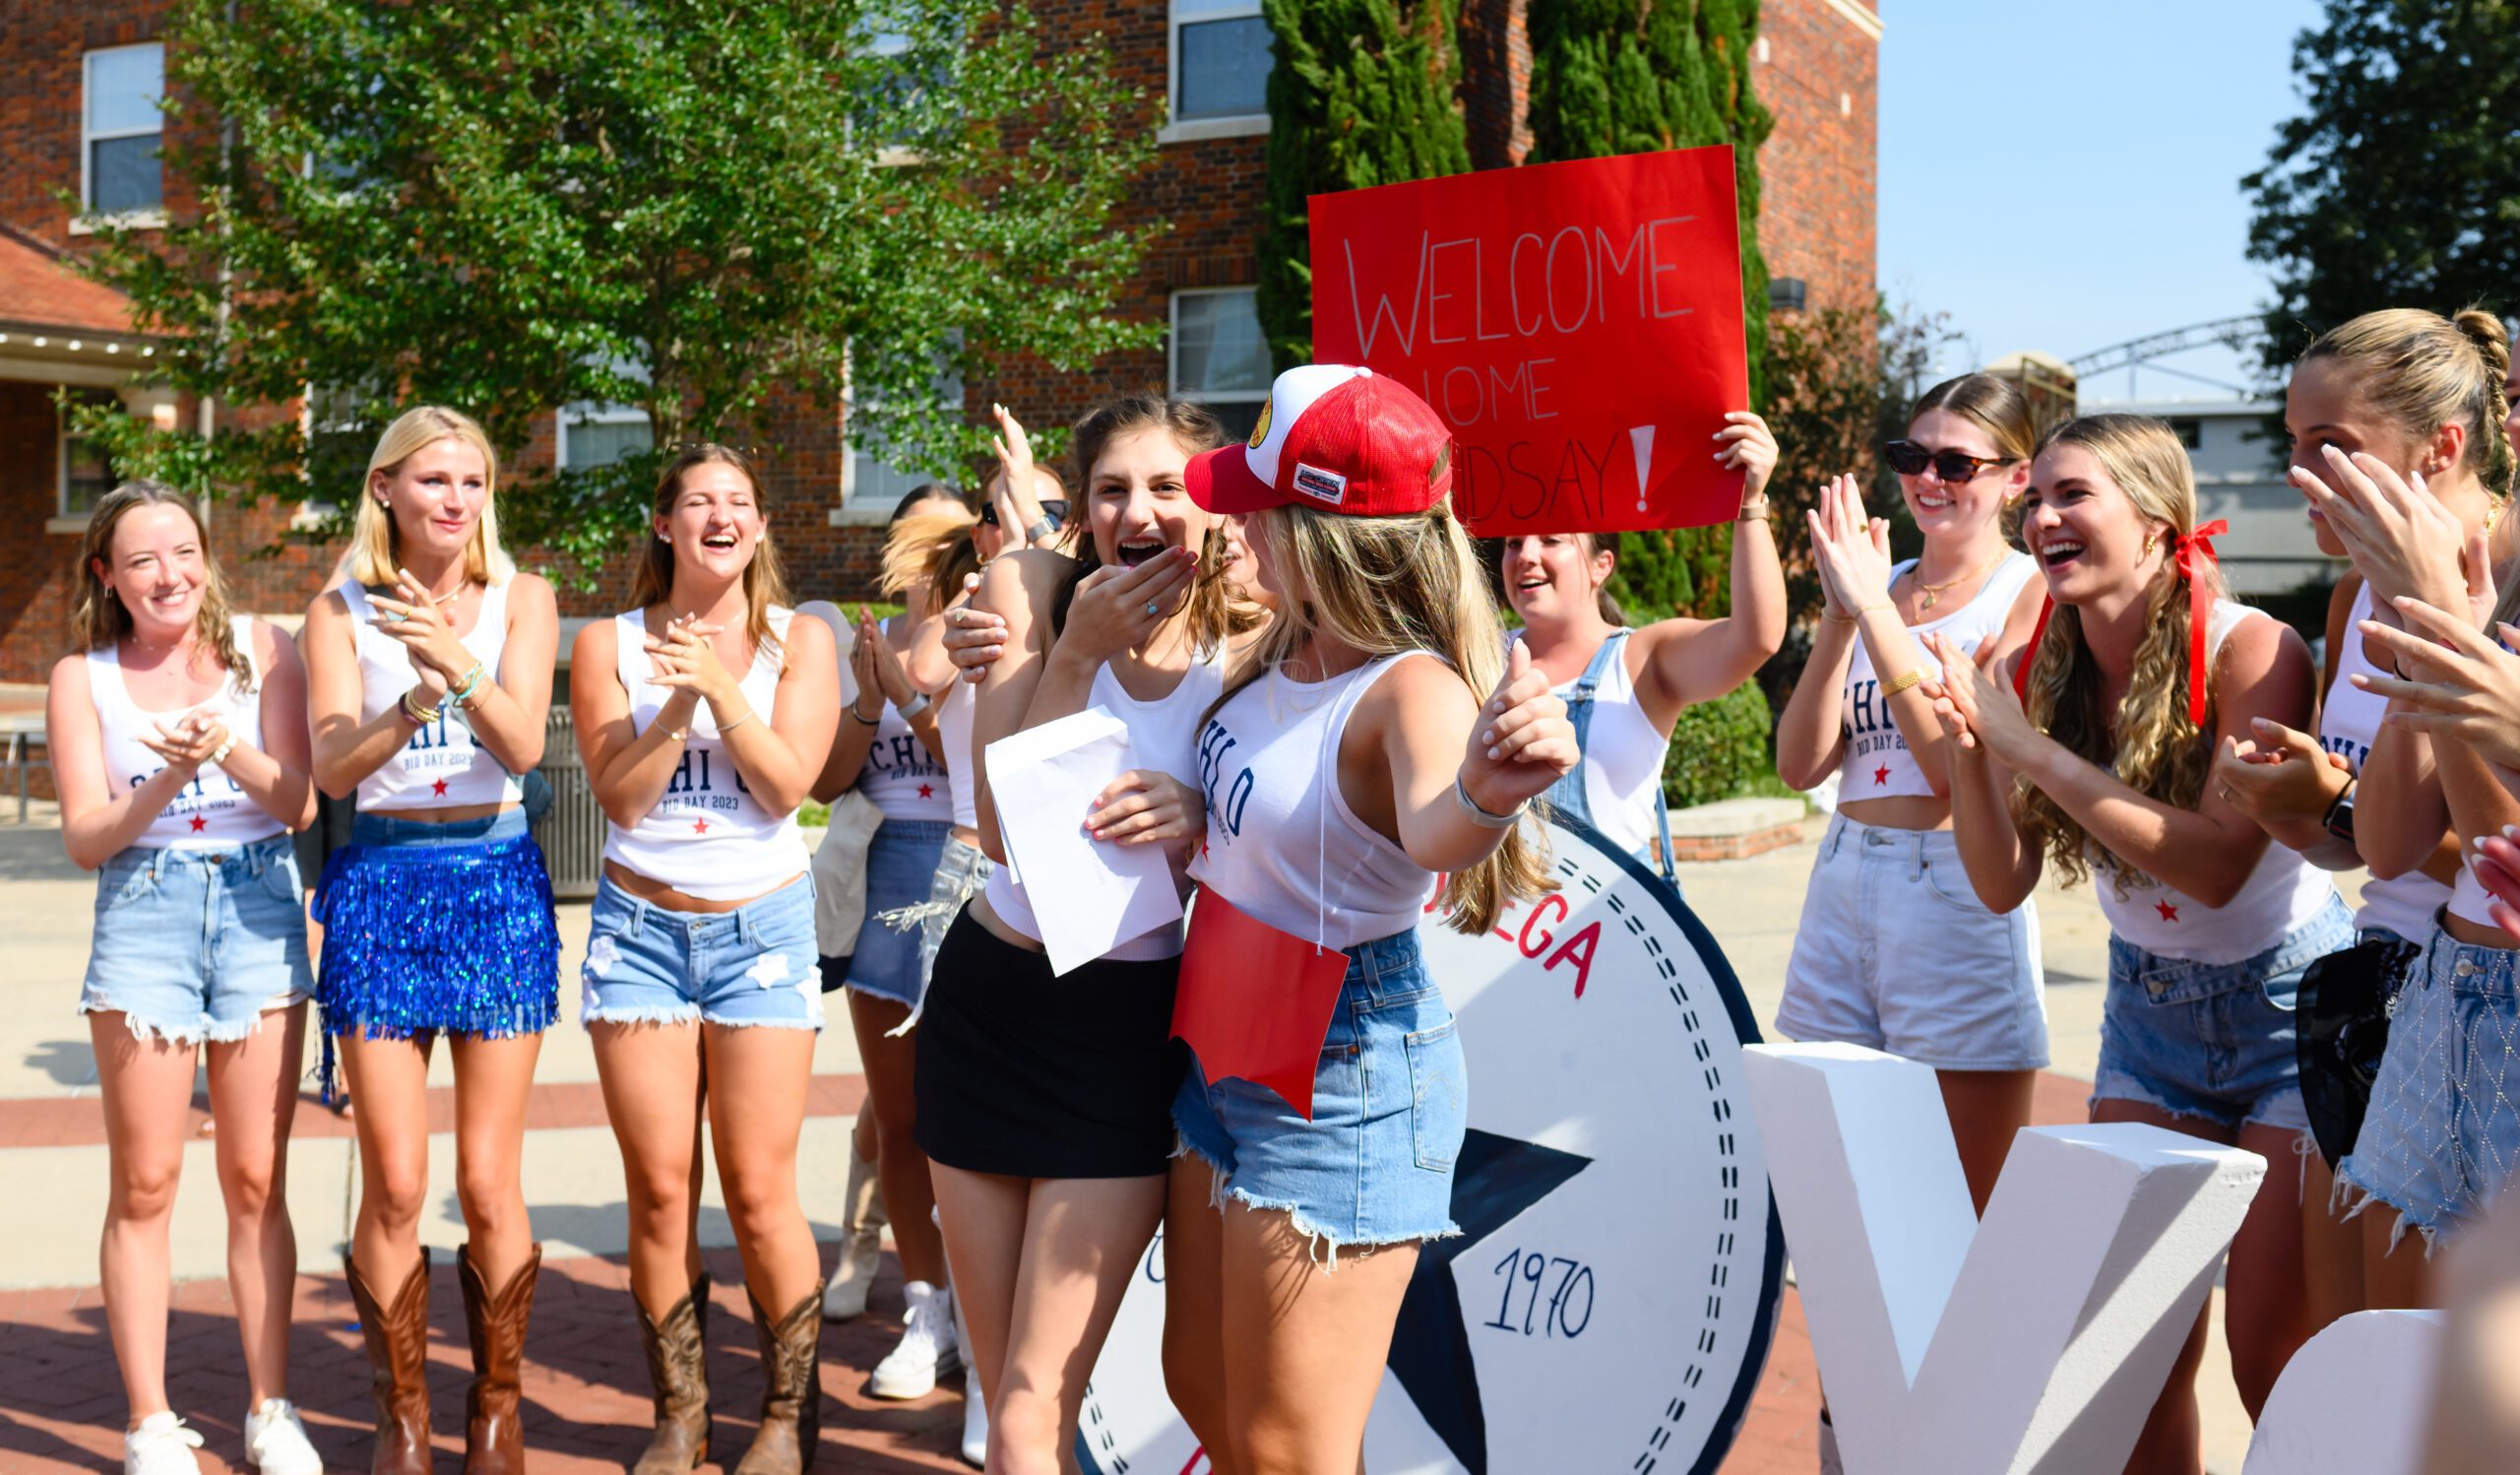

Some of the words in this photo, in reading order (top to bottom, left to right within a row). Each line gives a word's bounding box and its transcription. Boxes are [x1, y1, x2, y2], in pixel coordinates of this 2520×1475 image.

[1344, 214, 1700, 360] WELCOME
[1873, 734, 1892, 751] DAY
[667, 748, 712, 795] HI
[684, 795, 707, 809] DAY
[712, 795, 739, 811] 2023
[1483, 1246, 1594, 1339] 1970
